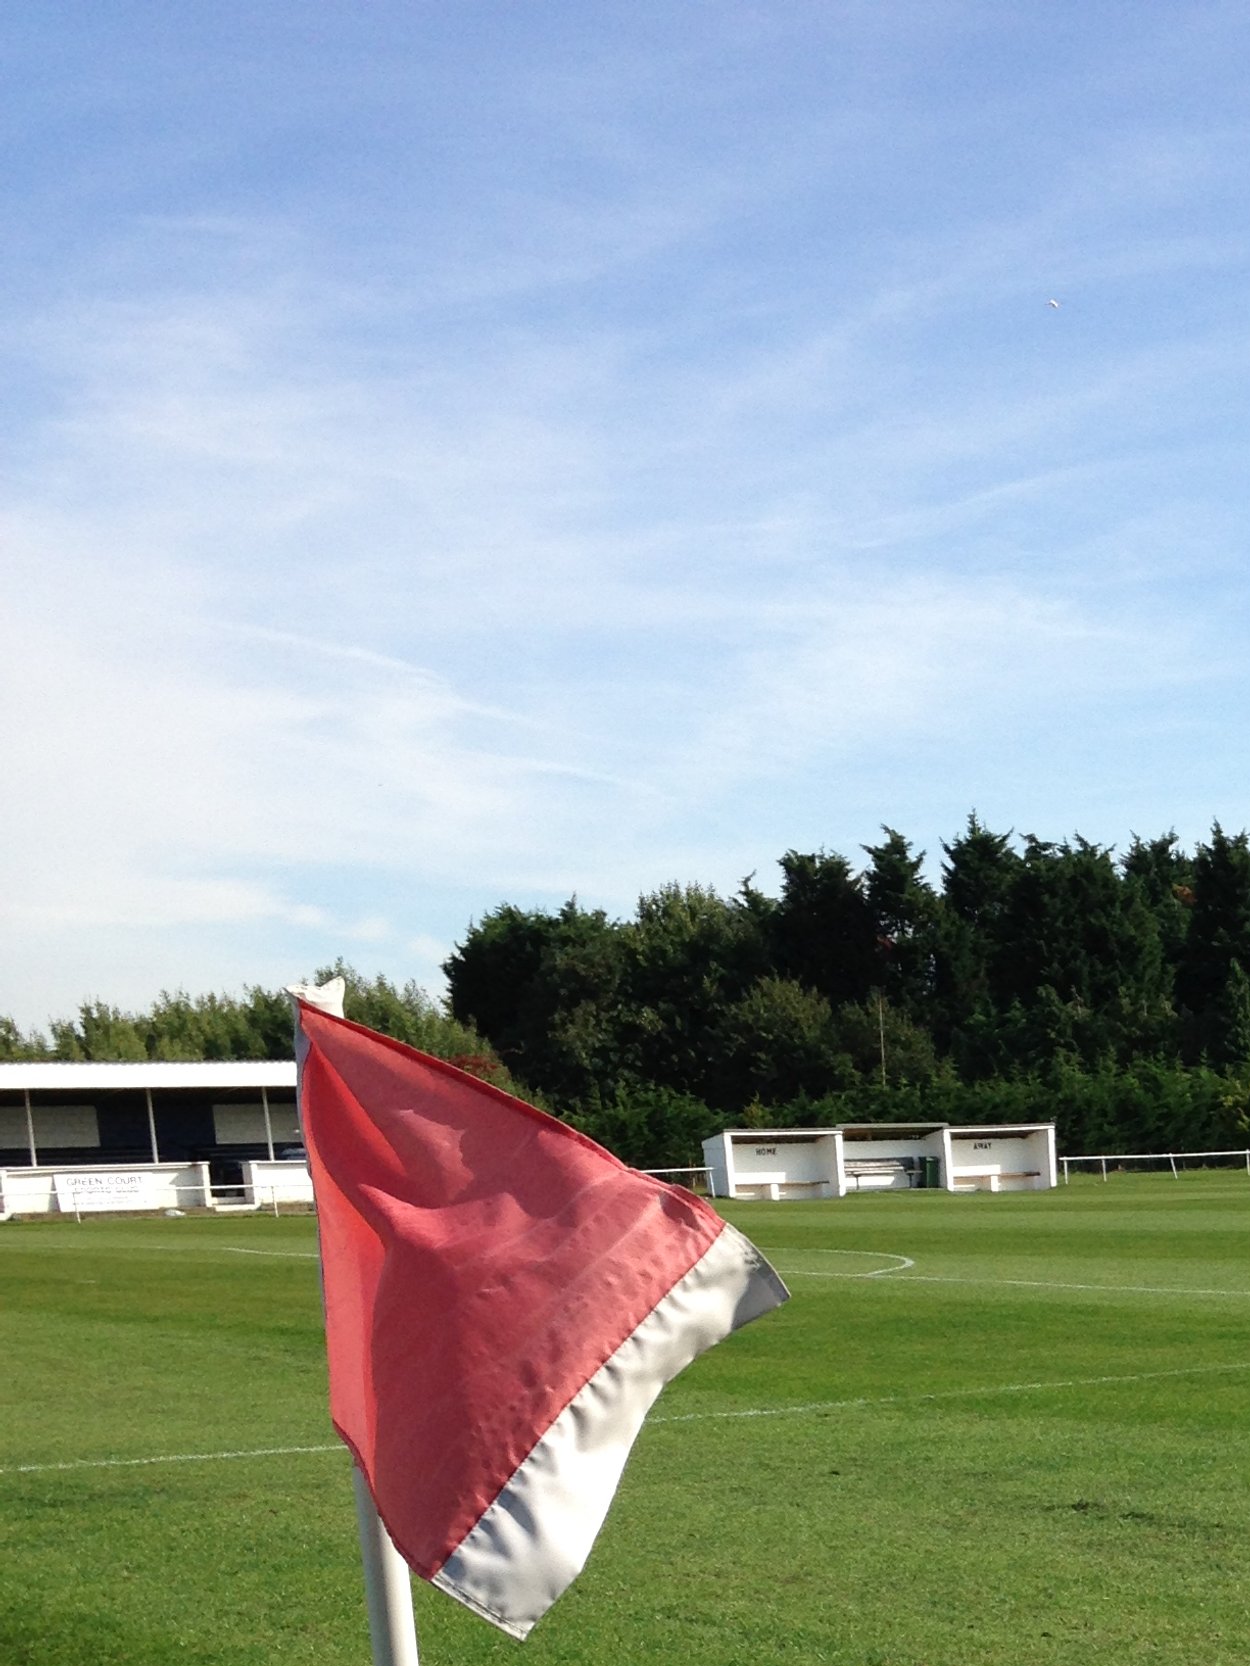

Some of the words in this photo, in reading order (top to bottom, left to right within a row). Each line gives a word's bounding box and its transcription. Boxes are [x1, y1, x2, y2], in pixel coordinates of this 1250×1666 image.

[973, 1142, 992, 1151] AWAY
[755, 1147, 777, 1156] HOME
[66, 1177, 103, 1186] GREEN
[107, 1176, 144, 1185] COURT
